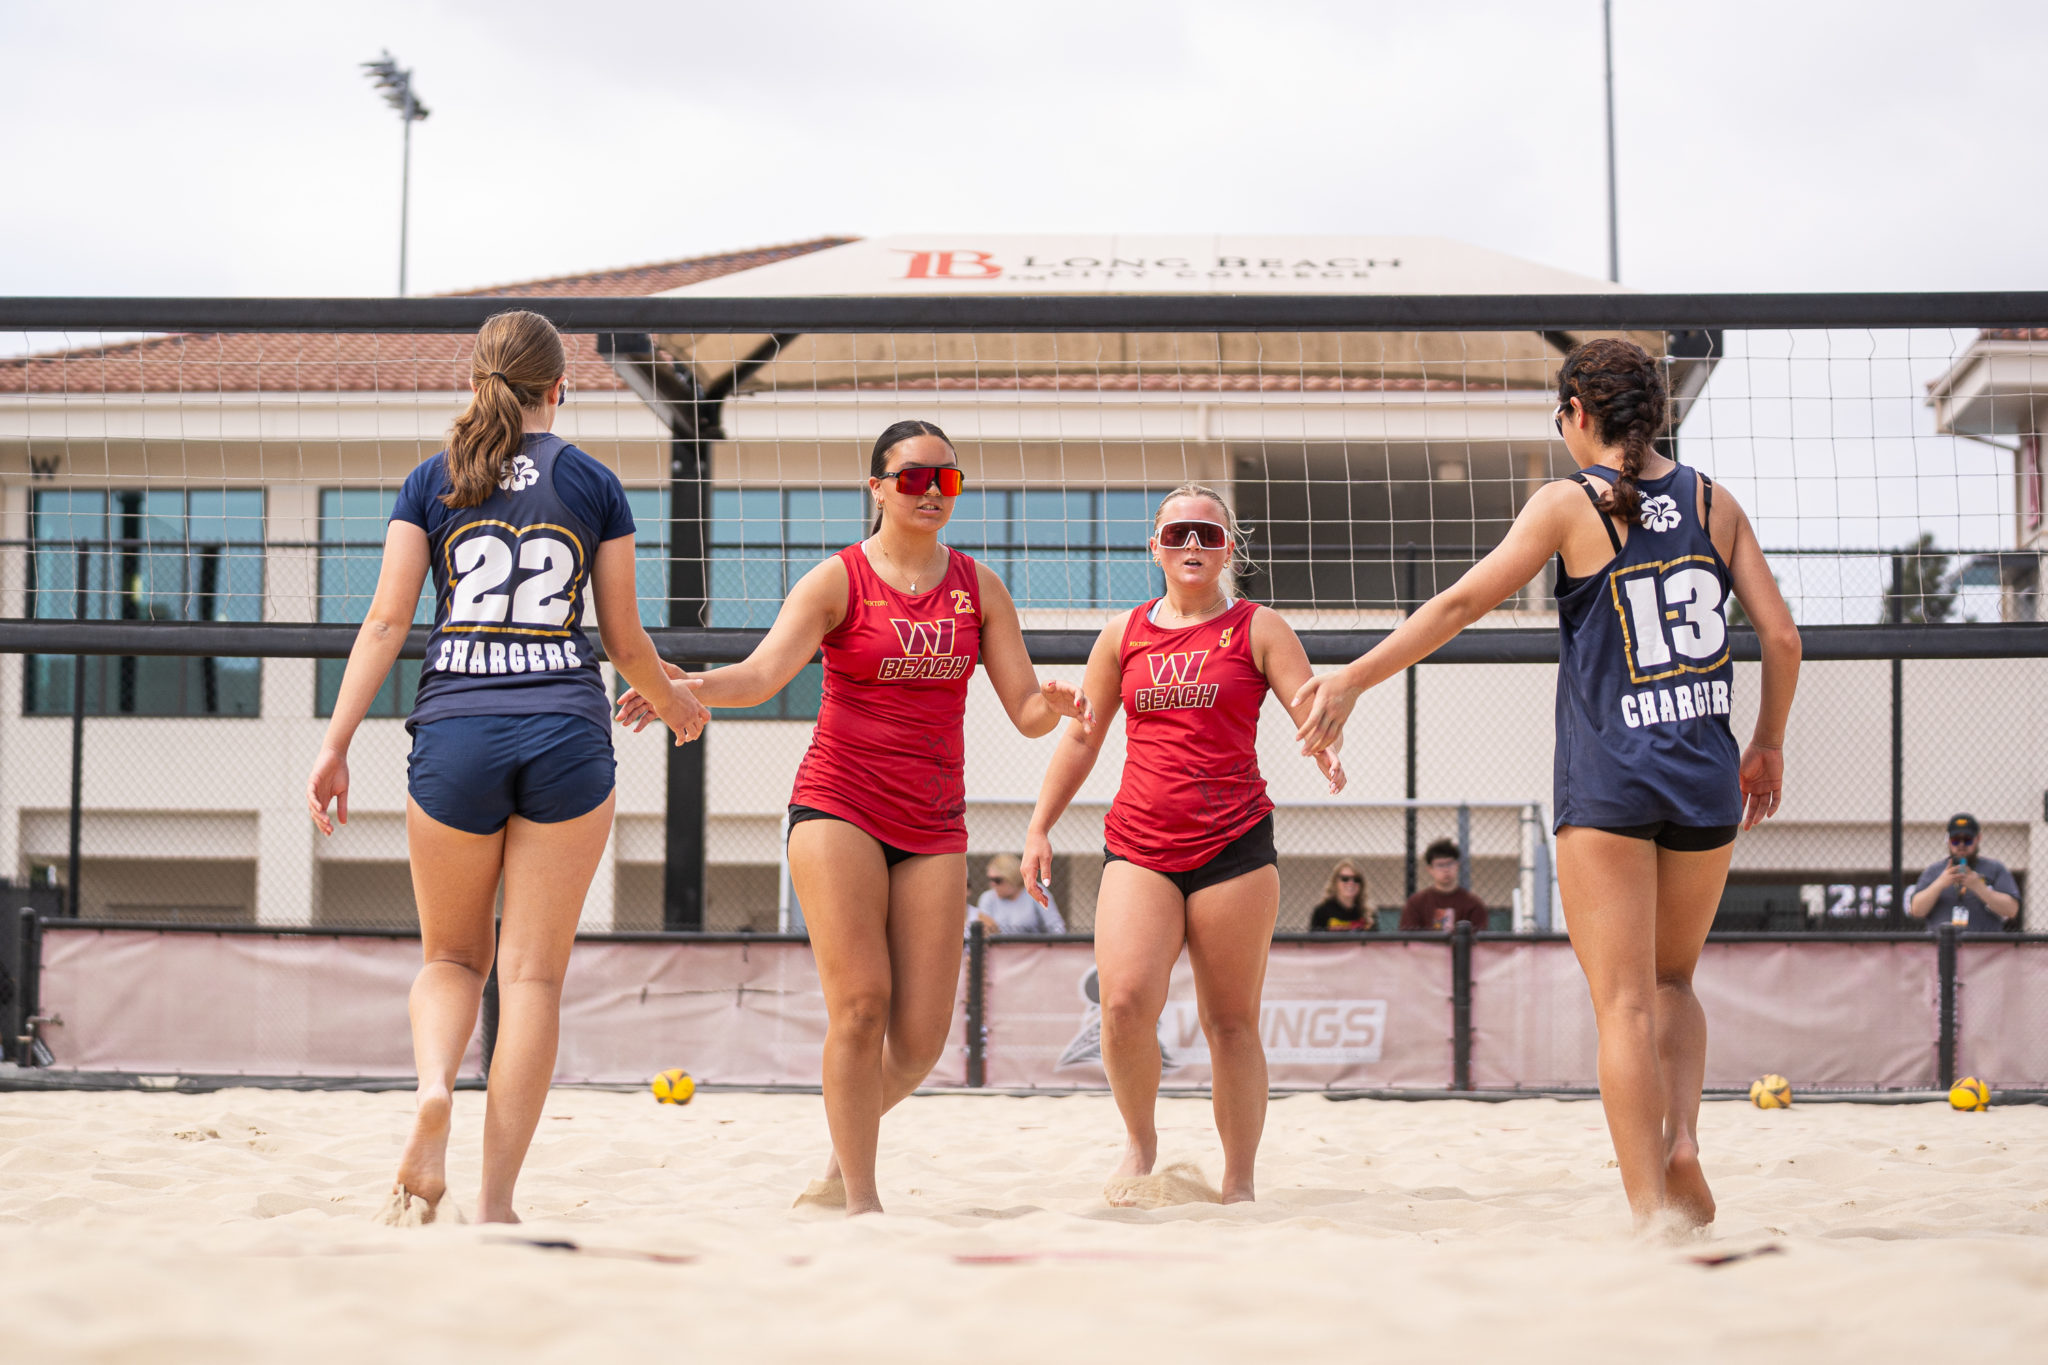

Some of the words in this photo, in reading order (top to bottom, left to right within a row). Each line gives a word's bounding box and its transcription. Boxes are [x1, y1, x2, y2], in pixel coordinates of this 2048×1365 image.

[1023, 256, 1190, 268] LONG
[1217, 257, 1401, 268] BEACH
[450, 535, 574, 626] 22
[1624, 568, 1726, 668] 13
[1219, 627, 1234, 648] 9
[435, 639, 582, 674] CHARGERS
[877, 655, 970, 680] BEACH
[1135, 683, 1220, 713] BEACH
[1176, 1007, 1377, 1048] VINGS
